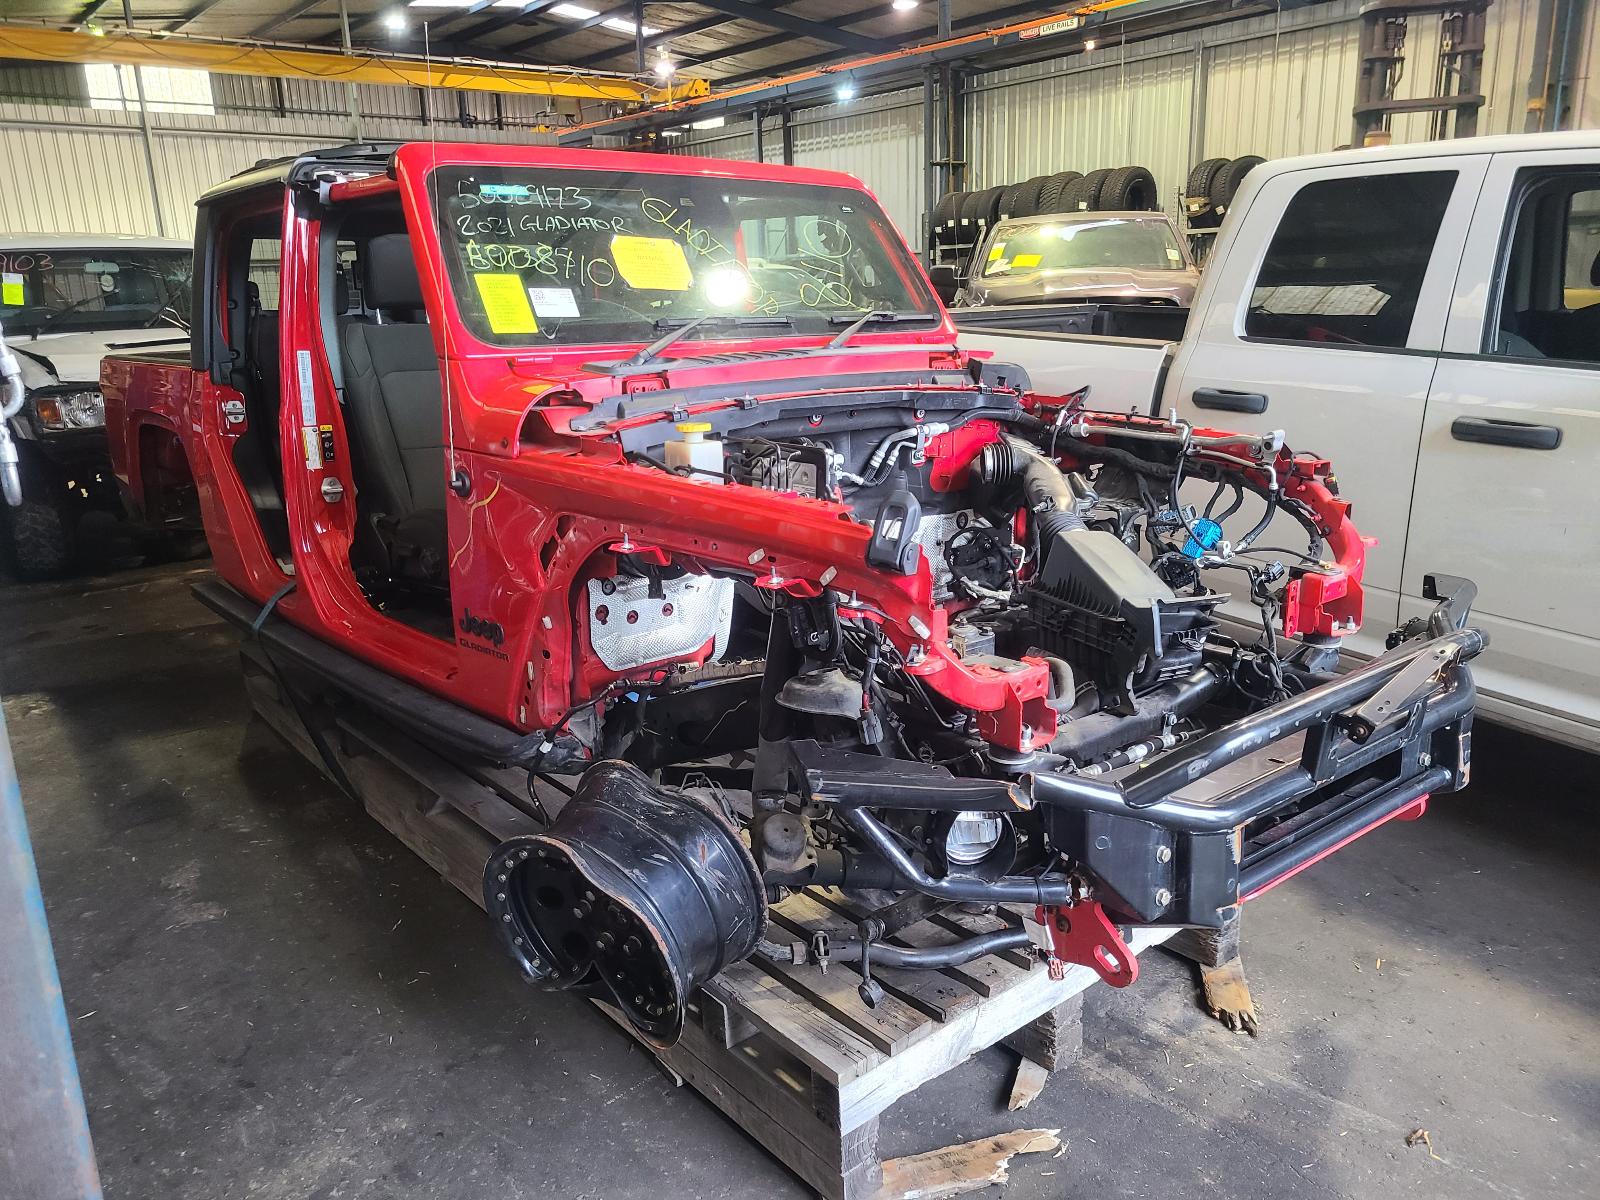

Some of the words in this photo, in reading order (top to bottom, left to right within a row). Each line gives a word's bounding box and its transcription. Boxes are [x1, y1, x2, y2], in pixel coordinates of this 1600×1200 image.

[1042, 24, 1056, 32] LIVE
[1056, 20, 1075, 29] RAILS
[456, 214, 516, 238] 2021
[519, 214, 634, 235] GLADIATOR
[641, 197, 779, 317] GLADIOR
[460, 607, 505, 650] Jeep
[459, 637, 511, 663] GLADIATOR
